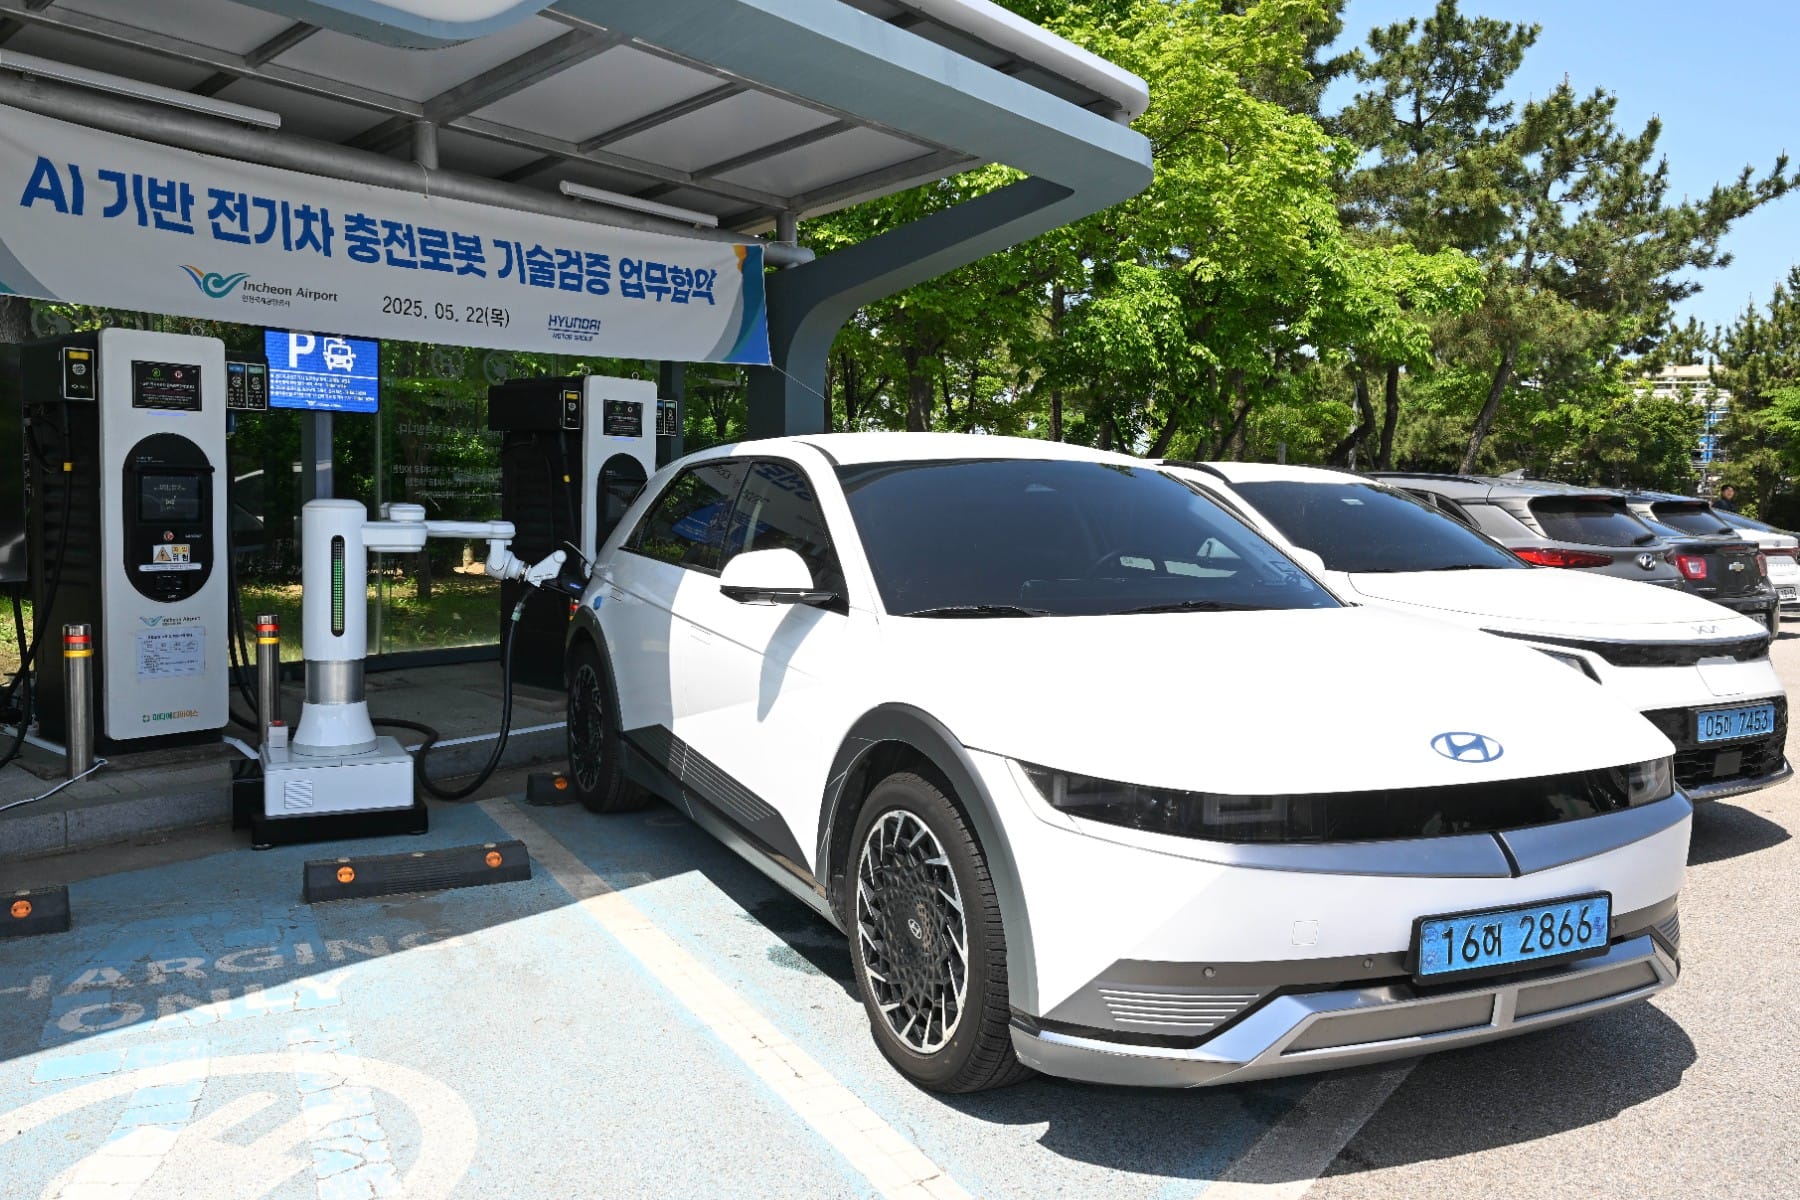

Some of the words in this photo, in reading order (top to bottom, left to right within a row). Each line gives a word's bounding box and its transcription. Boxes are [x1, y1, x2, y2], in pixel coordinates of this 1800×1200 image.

[21, 156, 84, 216] AI
[98, 169, 195, 235] 기반
[208, 188, 334, 257] 전기차
[344, 213, 488, 279] 충전로봇
[494, 239, 612, 296] 기술검증
[619, 257, 718, 305] 업무협약
[243, 280, 292, 297] Incheon
[296, 287, 338, 302] Airport
[382, 295, 428, 320] 2025.
[434, 302, 459, 322] 05.
[466, 306, 510, 329] 22(목)
[548, 314, 601, 331] HYUNDAI
[288, 329, 316, 369] P
[1739, 709, 1768, 733] 7453
[1441, 922, 1503, 966] 16허
[1519, 905, 1592, 954] 2866
[56, 969, 353, 1033] ONLY
